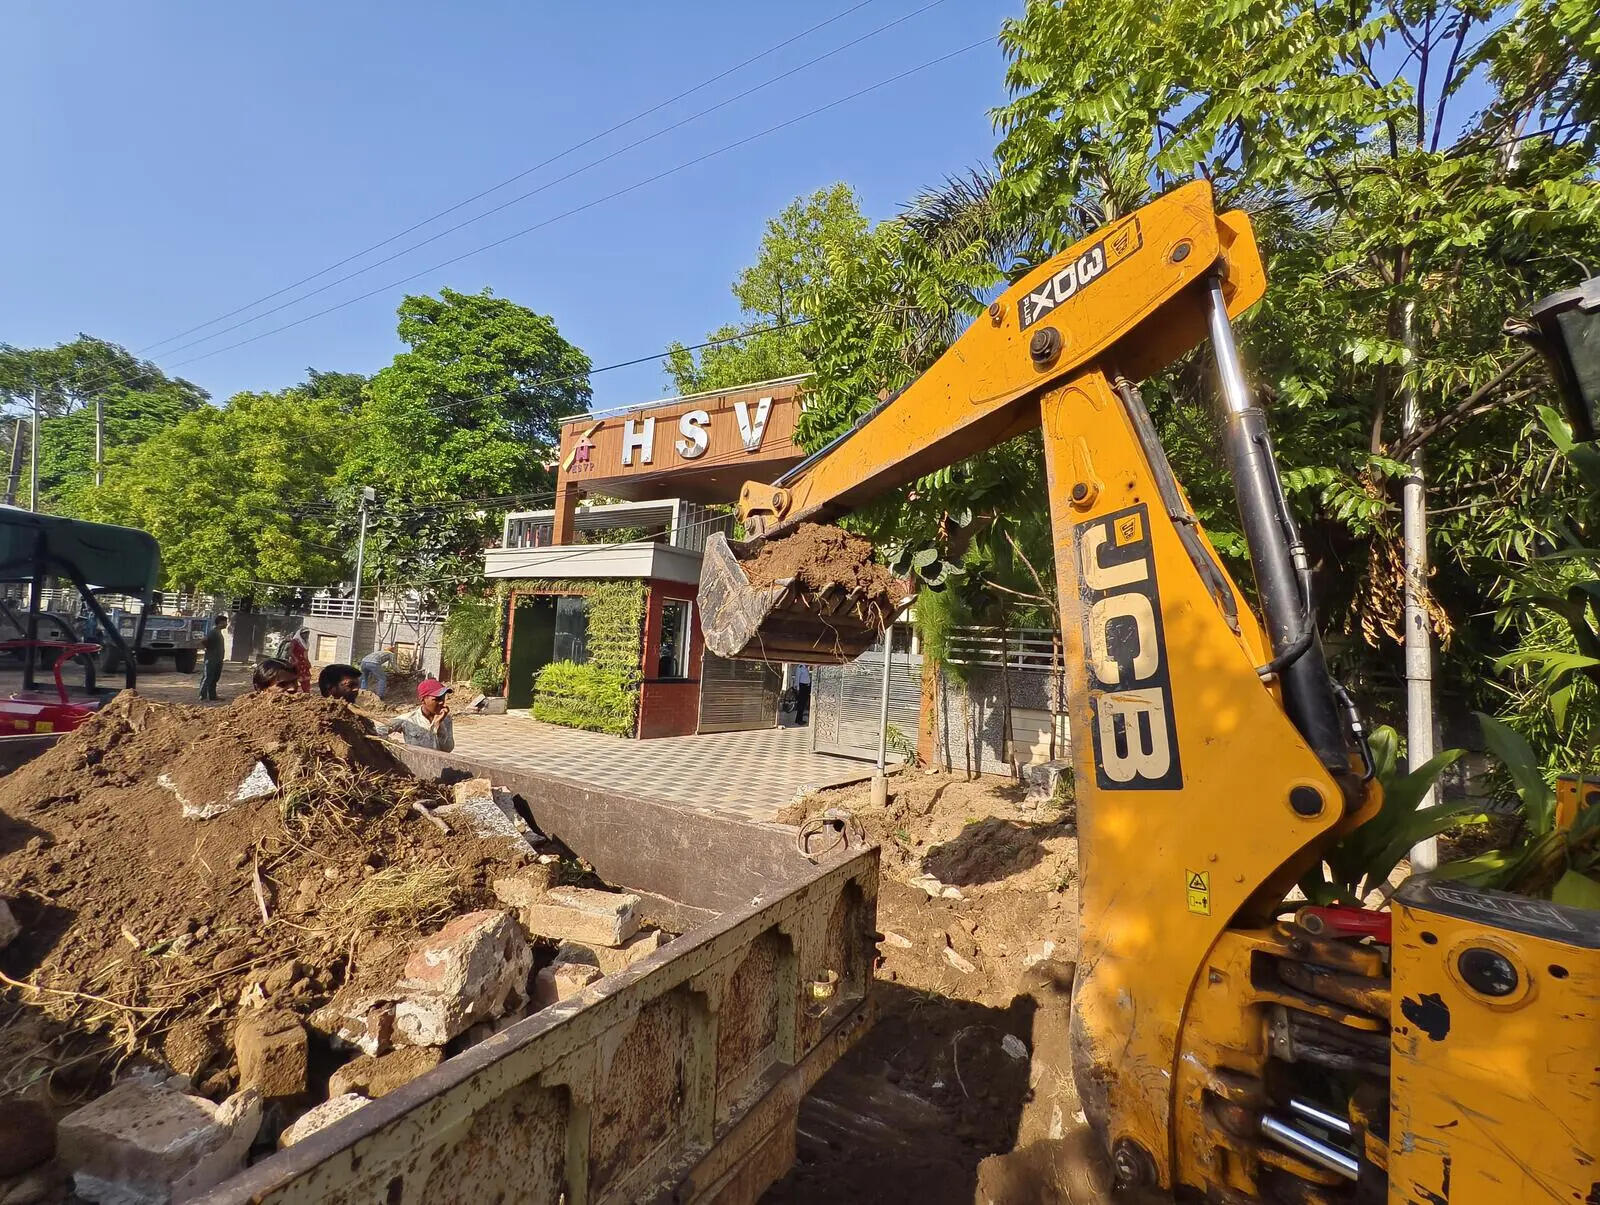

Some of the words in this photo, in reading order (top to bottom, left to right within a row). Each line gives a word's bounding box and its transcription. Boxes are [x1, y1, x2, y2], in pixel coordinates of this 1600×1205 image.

[1023, 296, 1032, 326] PLUS
[1030, 248, 1104, 322] 3DX
[1121, 521, 1134, 540] JCB
[1081, 523, 1171, 782] JCB
